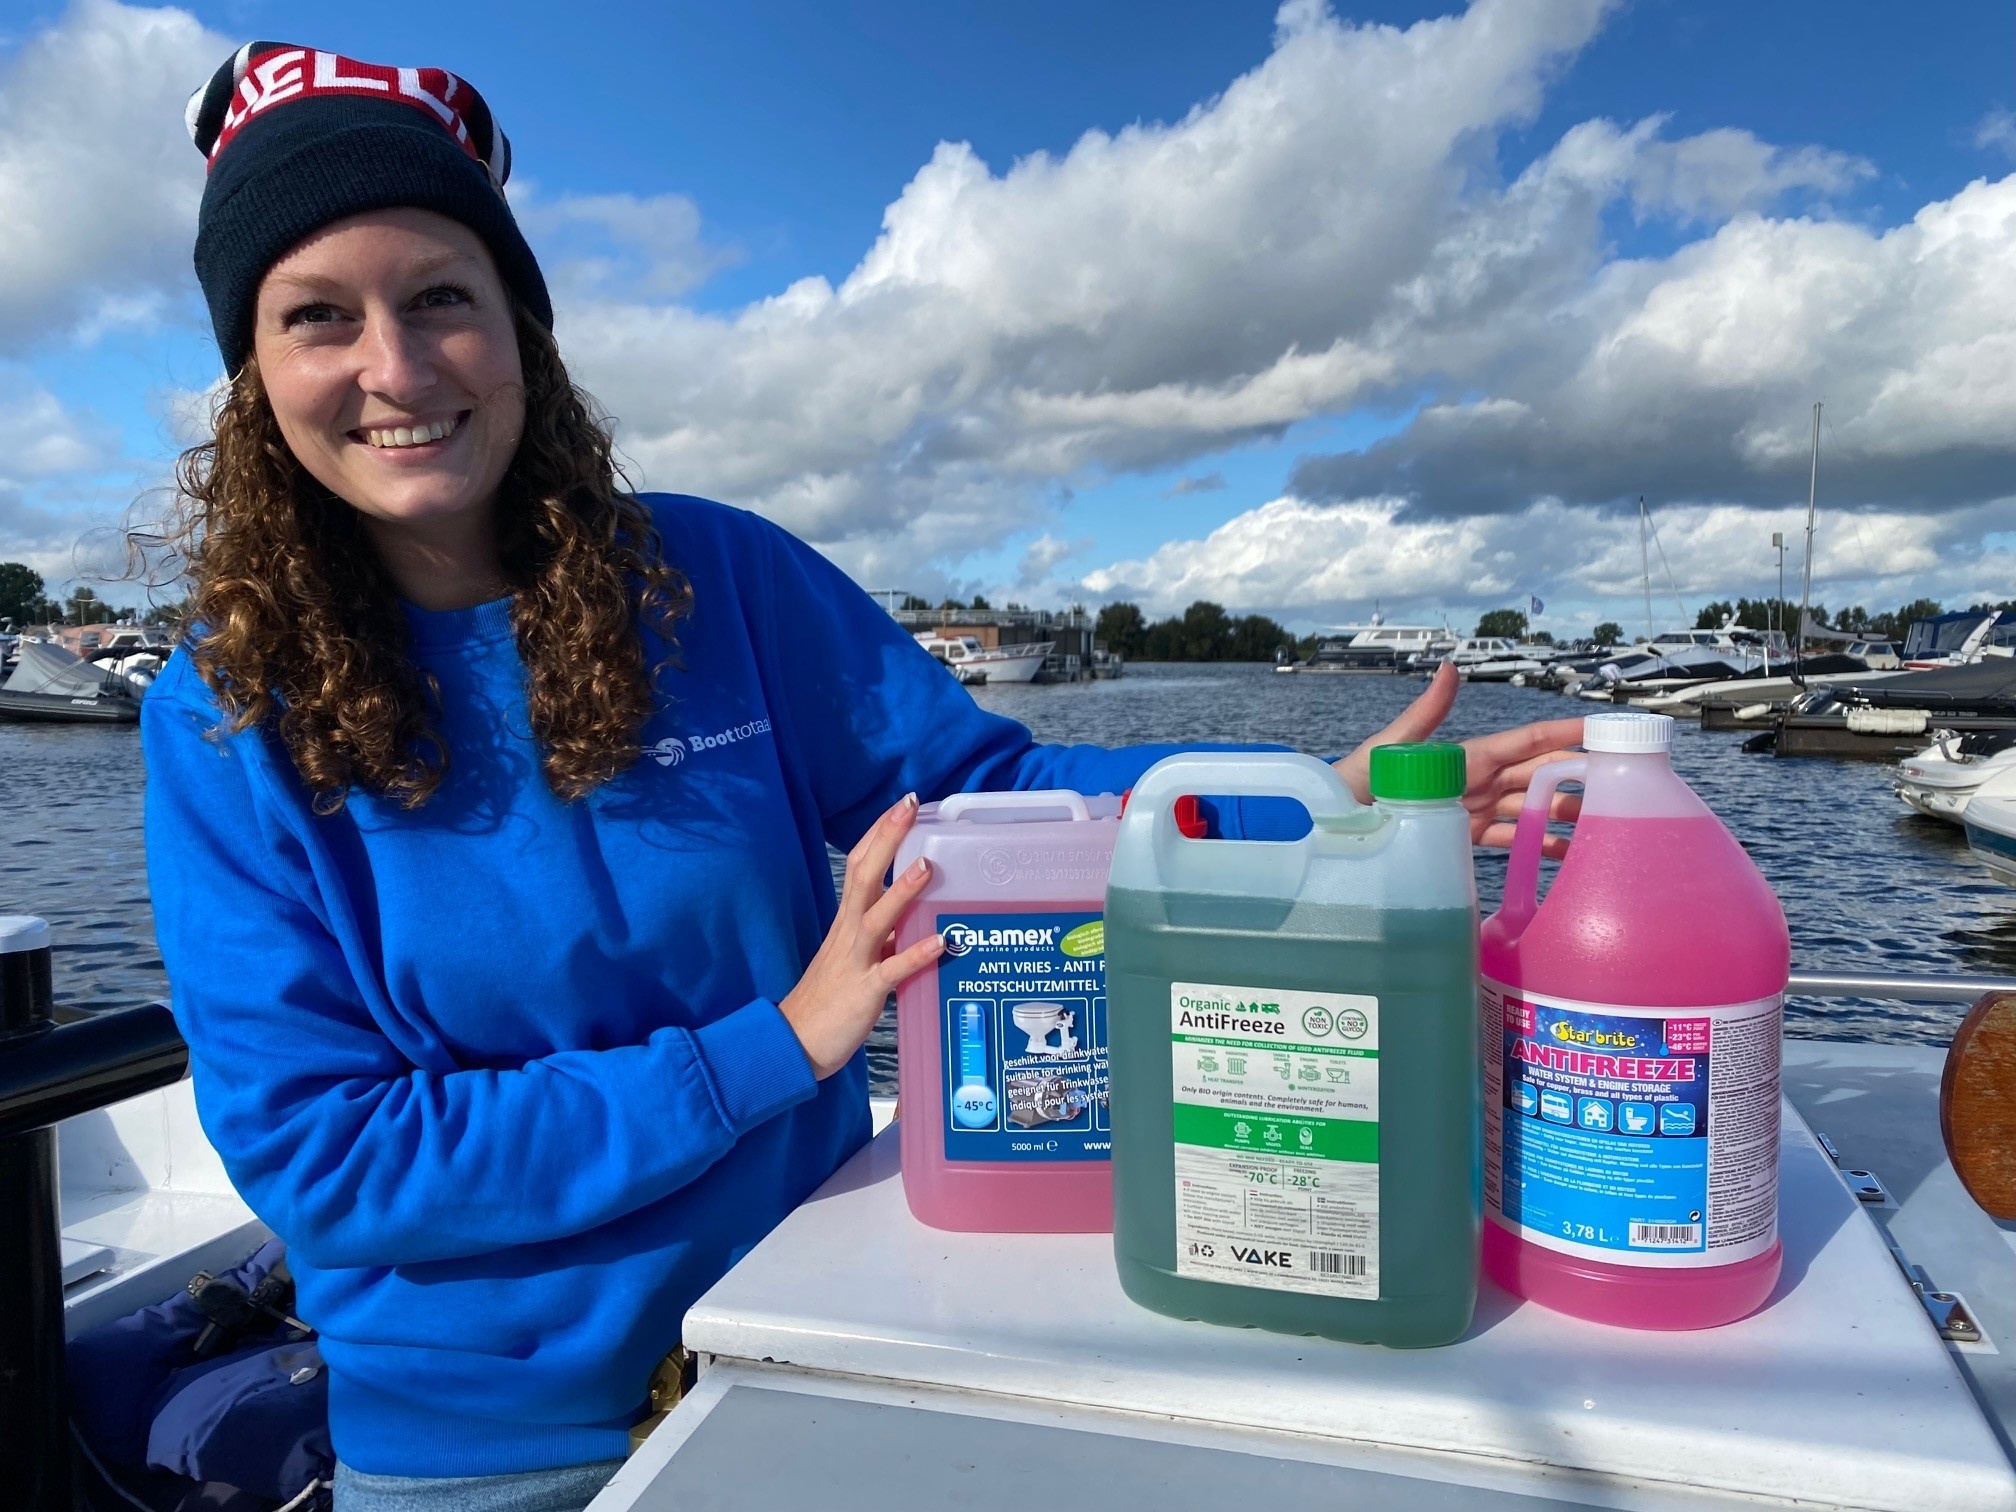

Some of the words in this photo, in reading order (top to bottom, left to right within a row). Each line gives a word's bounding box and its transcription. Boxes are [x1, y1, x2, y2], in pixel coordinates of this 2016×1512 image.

[978, 962, 1010, 974] ANTI
[1013, 961, 1051, 974] VRIES
[1063, 961, 1095, 973] ANTI
[958, 980, 1099, 993] FROSTSCHUTZMITTEL
[1180, 996, 1231, 1012] Organic
[1506, 1004, 1531, 1019] READY
[1180, 1011, 1285, 1035] AntiFreeze
[1308, 1022, 1328, 1030] TOXIC
[1310, 1016, 1326, 1024] NON
[1506, 1013, 1515, 1024] TO
[1516, 1017, 1531, 1030] USE
[1184, 1036, 1214, 1044] MINIMIZES
[1254, 1042, 1287, 1050] COLLECTION
[1313, 1047, 1347, 1055] ANTIFREEZE
[1003, 1055, 1038, 1069] geschikt
[1040, 1052, 1060, 1063] voor
[1510, 1038, 1695, 1081] ANTIFREEZE
[1006, 1069, 1039, 1082] suitable
[1042, 1068, 1054, 1078] for
[1056, 1064, 1092, 1076] drinking
[1528, 1066, 1553, 1080] WATER
[1554, 1072, 1588, 1086] SYSTEM
[1589, 1079, 1596, 1088] &
[1598, 1080, 1630, 1091] ENGINE
[1631, 1083, 1671, 1093] STORAGE
[1008, 1085, 1044, 1098] geeignet
[1047, 1081, 1059, 1091] für
[1061, 1075, 1108, 1090] Trinkwasse
[1522, 1074, 1535, 1083] Safe
[1536, 1077, 1545, 1086] for
[1547, 1082, 1571, 1093] copper,
[1573, 1086, 1593, 1096] brass
[1595, 1089, 1609, 1098] and
[1622, 1092, 1642, 1101] types
[1654, 1094, 1679, 1102] plastic
[1044, 1097, 1064, 1110] pour
[1066, 1094, 1079, 1104] les
[1081, 1089, 1109, 1103] systèm
[1182, 1086, 1197, 1094] Only
[1212, 1090, 1232, 1098] origin
[1234, 1092, 1265, 1101] contents.
[1268, 1095, 1307, 1105] Completely
[1337, 1101, 1369, 1111] humans,
[1220, 1097, 1248, 1106] animals
[1264, 1101, 1276, 1109] the
[1277, 1103, 1325, 1114] environment.
[1012, 1143, 1032, 1151] 5000
[1034, 1142, 1043, 1151] ml
[1563, 1220, 1595, 1239] 3,78
[1599, 1228, 1608, 1242] L
